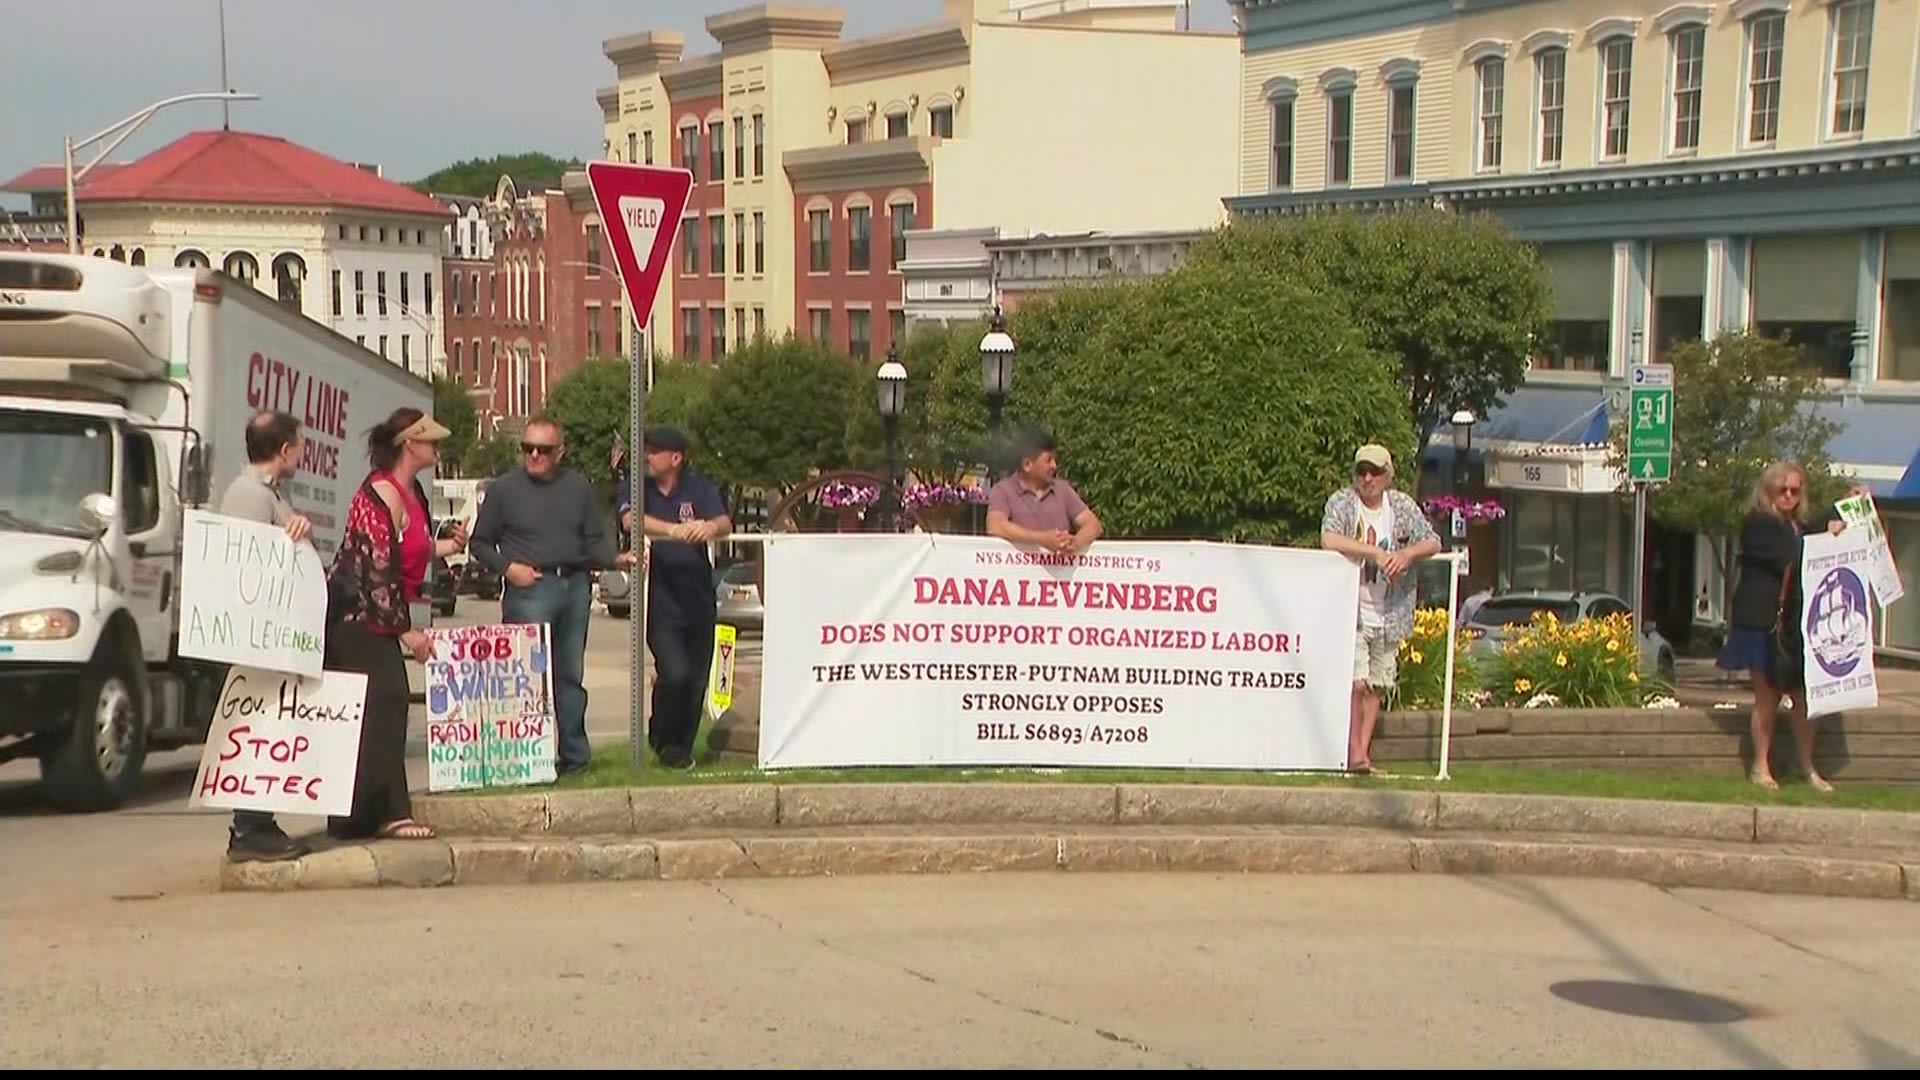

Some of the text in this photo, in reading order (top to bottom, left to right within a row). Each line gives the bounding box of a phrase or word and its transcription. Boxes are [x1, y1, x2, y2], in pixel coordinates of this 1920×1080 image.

[627, 207, 657, 228] YIELD
[247, 351, 349, 440] CITY LINE
[296, 437, 339, 479] RVICE
[1524, 466, 1541, 481] 165
[195, 519, 305, 578] THANK
[976, 552, 1161, 572] NYS ASSEMBLY DISTRICT 95
[914, 577, 1218, 613] DANA LEVENBERG
[188, 604, 235, 648] AM
[821, 623, 886, 645] DOES
[893, 623, 945, 643] NOT
[951, 624, 1063, 645] SUPPORT
[1068, 626, 1206, 650] ORGANIZED
[1212, 631, 1290, 653] LABOR
[450, 637, 512, 660] JOB
[428, 661, 450, 676] TO
[812, 663, 1306, 689] THE WESTCHESTER-PUTNAM BUILDING TRADES
[962, 693, 1164, 714] STRONGLY OPPOSES
[219, 725, 310, 763] STOP
[977, 723, 1149, 744] BILL S6893/A7208
[431, 739, 545, 763] NO DUMPING
[200, 766, 323, 801] HOLTEC
[460, 760, 531, 783] HUDSON
